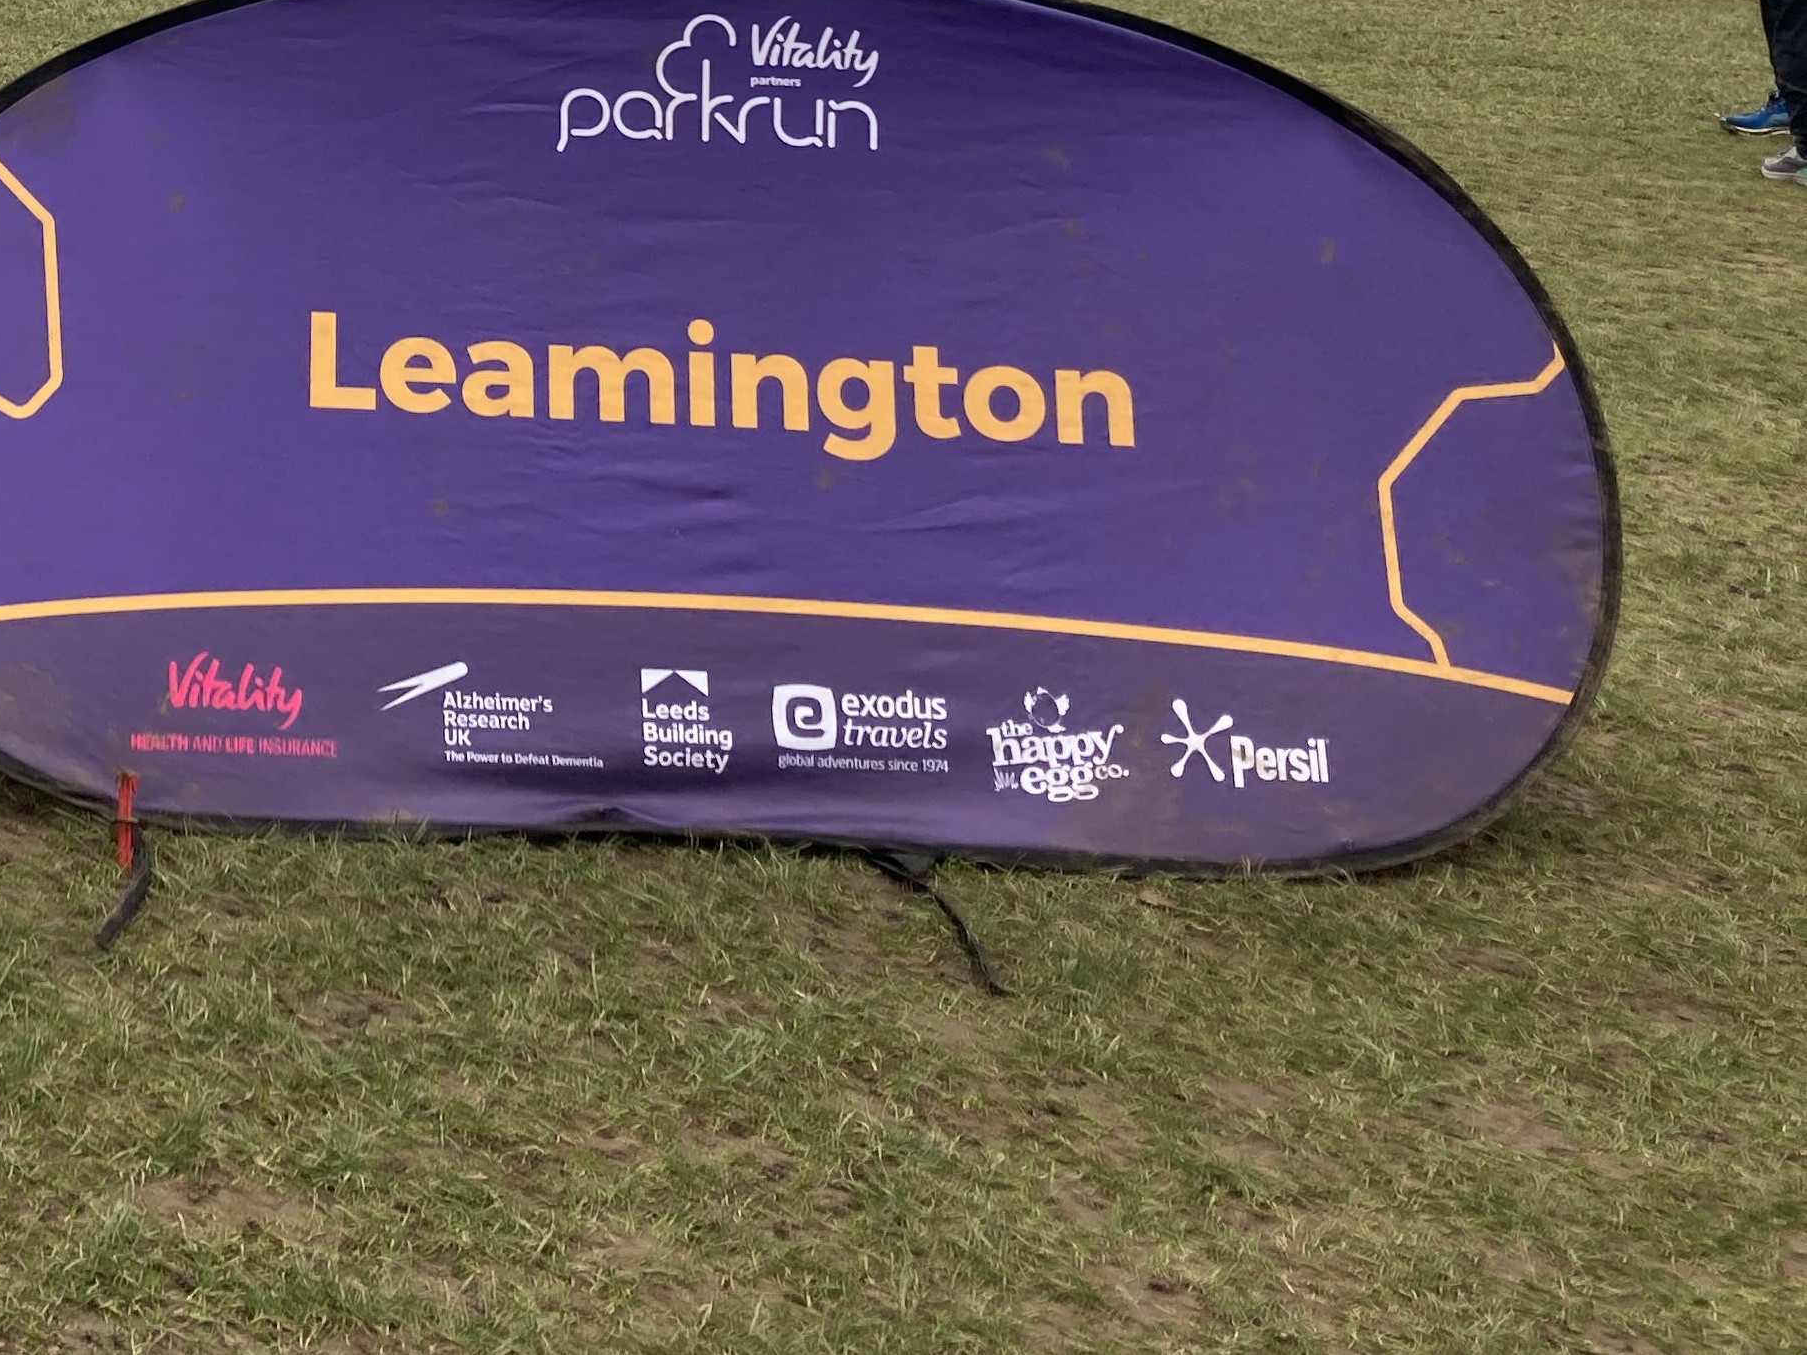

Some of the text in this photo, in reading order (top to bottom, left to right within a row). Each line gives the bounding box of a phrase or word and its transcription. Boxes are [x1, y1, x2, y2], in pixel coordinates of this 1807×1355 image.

[751, 15, 879, 88] Vitality
[750, 76, 802, 88] partners
[556, 58, 879, 153] parkrun
[308, 310, 1137, 461] Leamington
[168, 651, 303, 731] Vitality
[443, 690, 553, 714] Alzheimer's
[841, 689, 948, 721] exodus
[443, 709, 531, 731] Research
[641, 697, 710, 721] Leeds
[444, 728, 472, 746] UK
[642, 721, 733, 751] Building
[843, 717, 948, 750] travels
[1000, 719, 1034, 738] the
[130, 733, 338, 758] HEALTH AND LIFE INSURANCE
[444, 750, 604, 769] The Power to Defeat Dementia
[643, 745, 729, 775] Society
[986, 724, 1125, 768] happy
[778, 752, 949, 773] global adventures since 1974
[1230, 735, 1330, 789] Persil
[1020, 761, 1130, 803] egg co.
